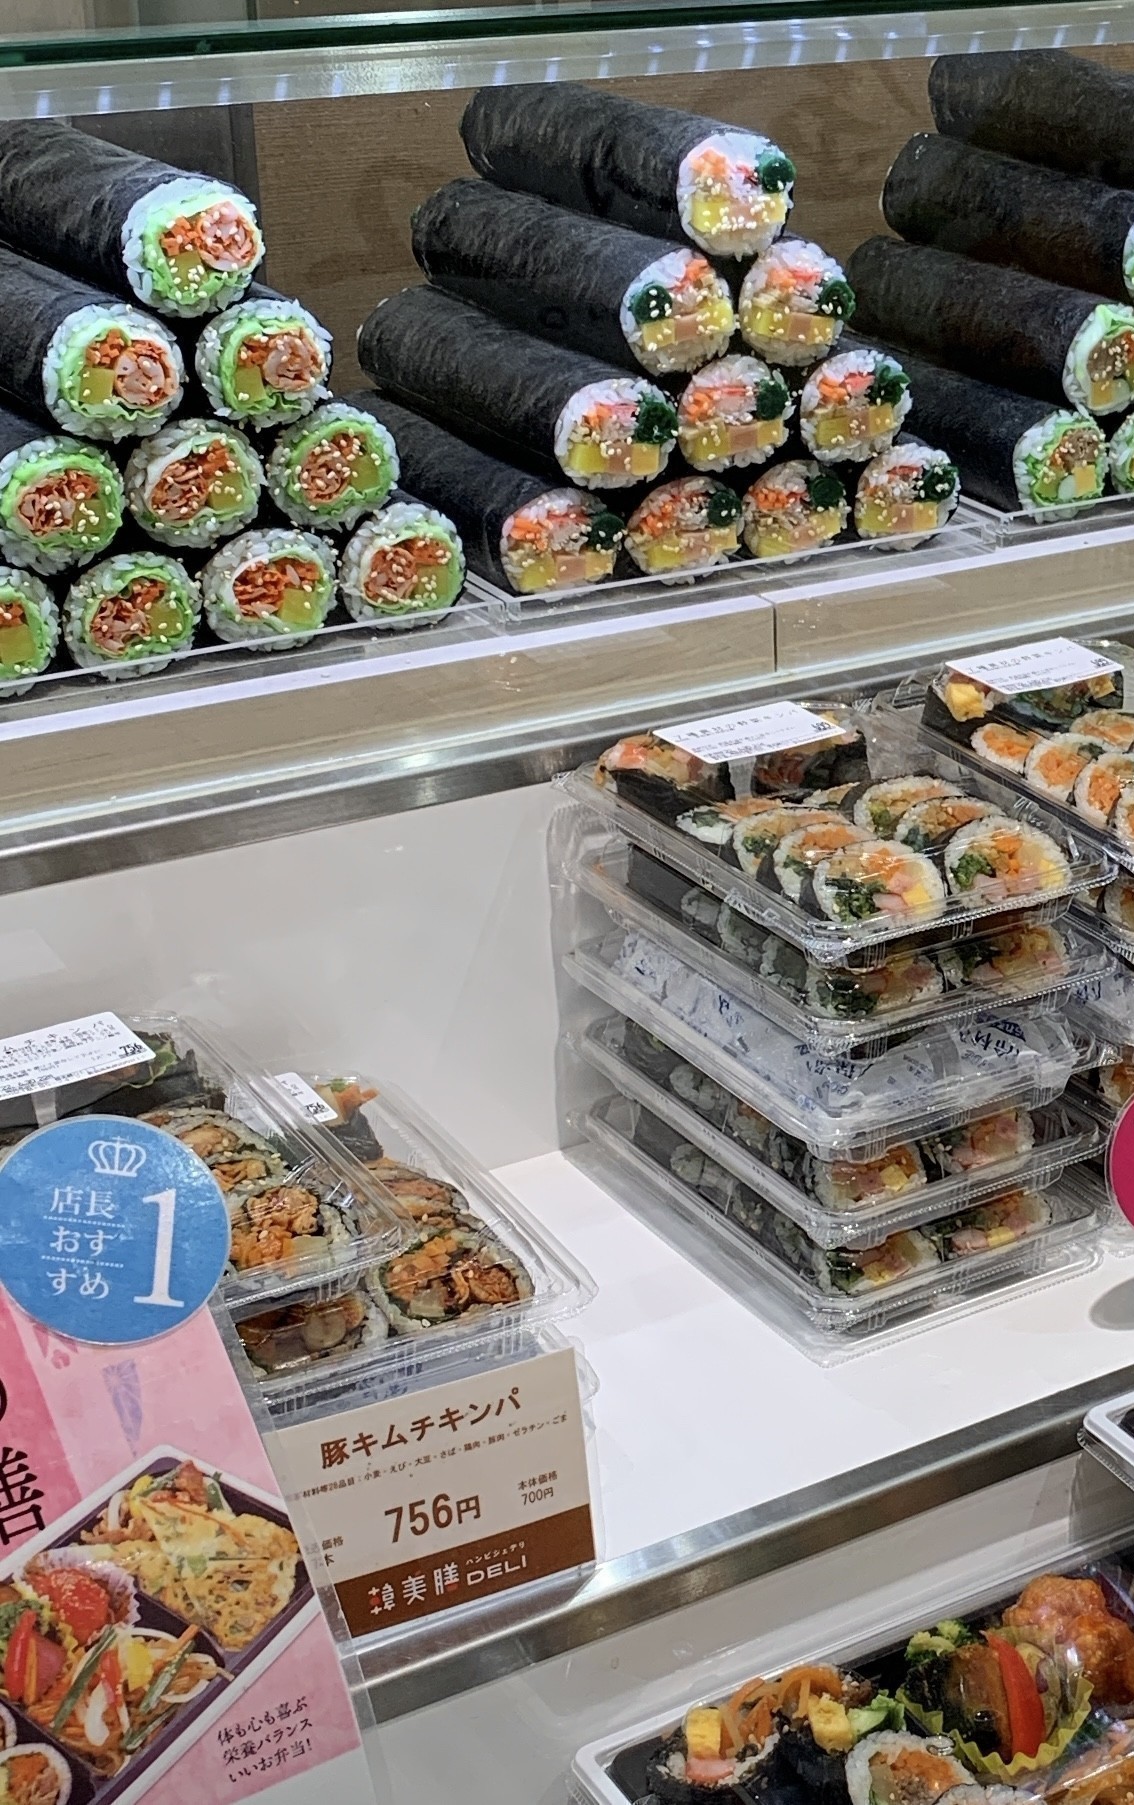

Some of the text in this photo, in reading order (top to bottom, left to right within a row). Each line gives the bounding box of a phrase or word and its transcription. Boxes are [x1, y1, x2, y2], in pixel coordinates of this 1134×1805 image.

[50, 1185, 115, 1219] 店長
[50, 1226, 115, 1256] おす
[133, 1188, 185, 1308] 1
[46, 1268, 109, 1300] すめ
[321, 1387, 522, 1469] 豚キムチキンパ
[517, 1470, 559, 1492] 本体価格
[521, 1487, 555, 1507] 700円
[384, 1493, 482, 1544] 756円
[467, 1554, 528, 1586] DELI
[218, 1695, 308, 1746] 体も心も喜ぶ
[223, 1718, 313, 1766] 栄養バランス
[229, 1738, 313, 1783] いいお弁当!
